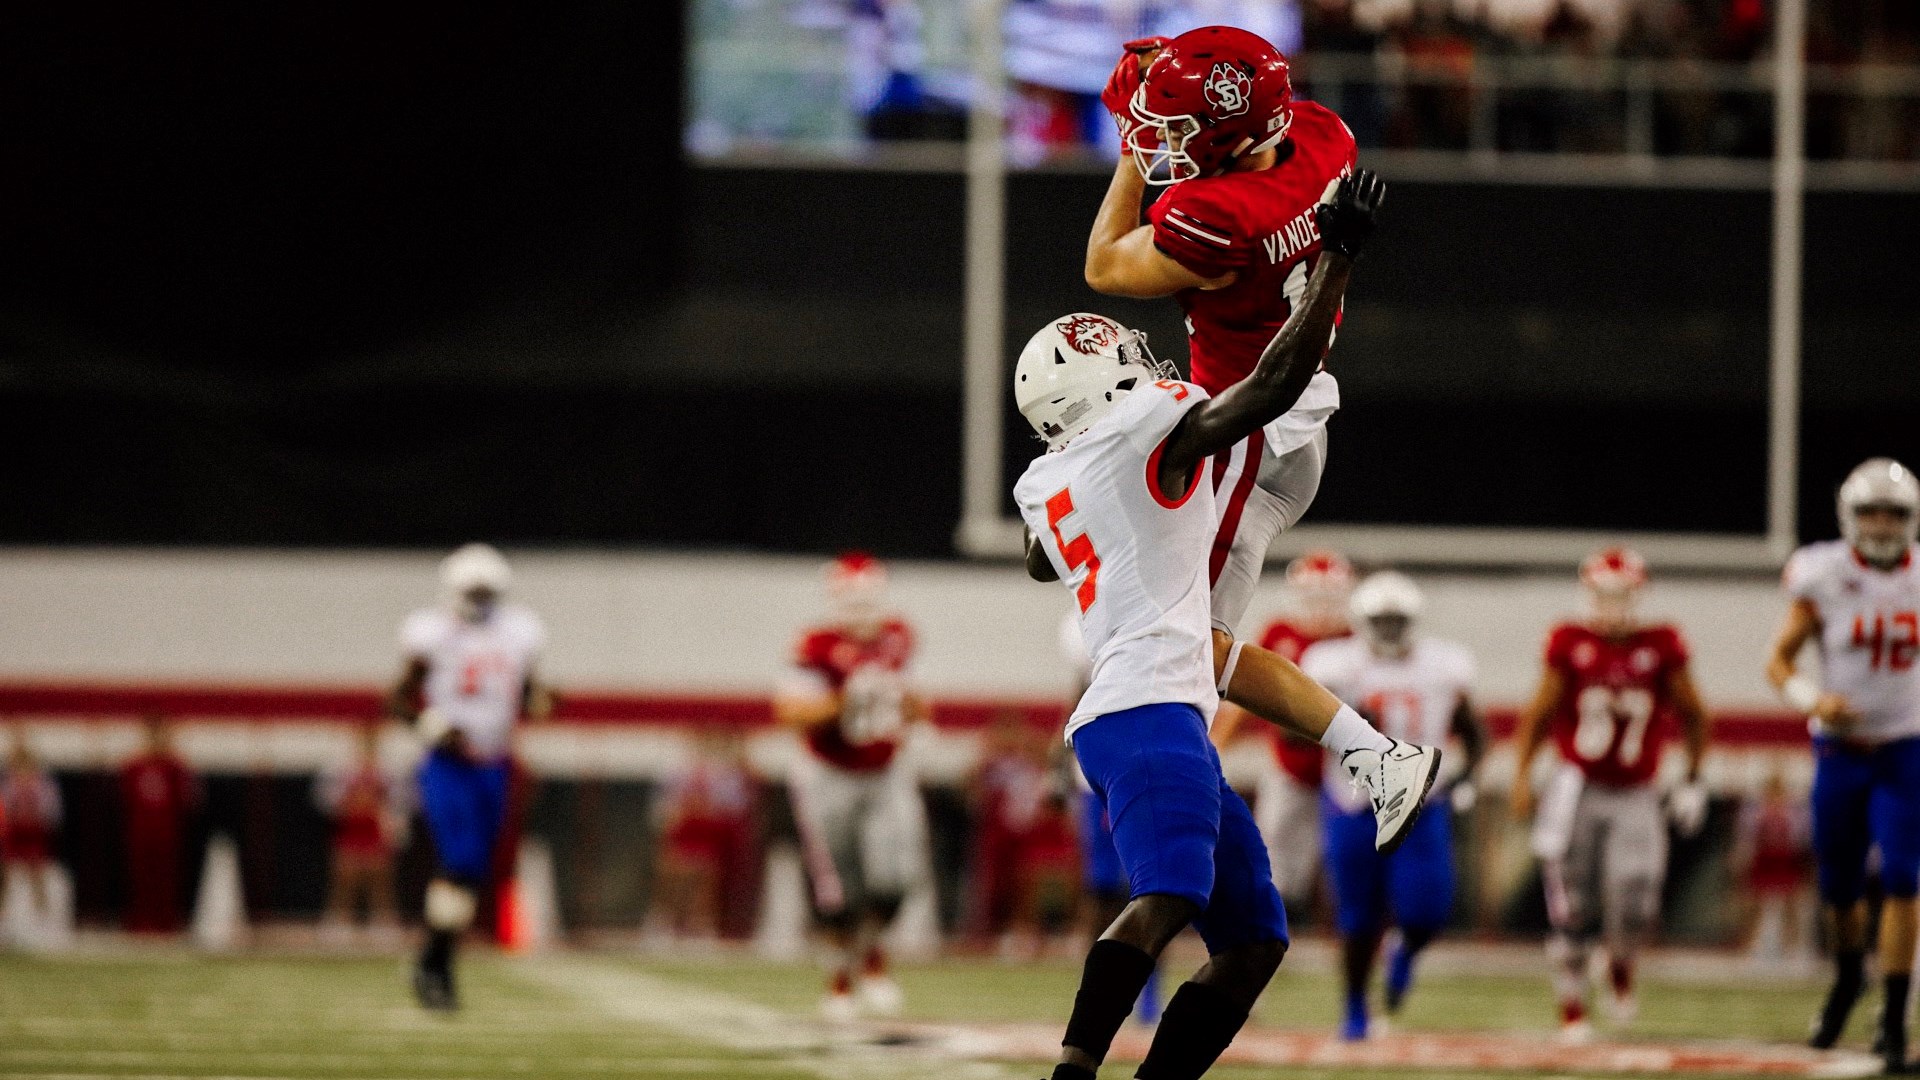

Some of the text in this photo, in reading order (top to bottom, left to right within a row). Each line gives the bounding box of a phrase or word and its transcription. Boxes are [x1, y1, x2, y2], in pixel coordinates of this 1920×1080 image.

[1263, 201, 1322, 264] VANDE
[1154, 378, 1190, 403] 5
[1045, 486, 1102, 616] 5
[1851, 610, 1919, 675] 42
